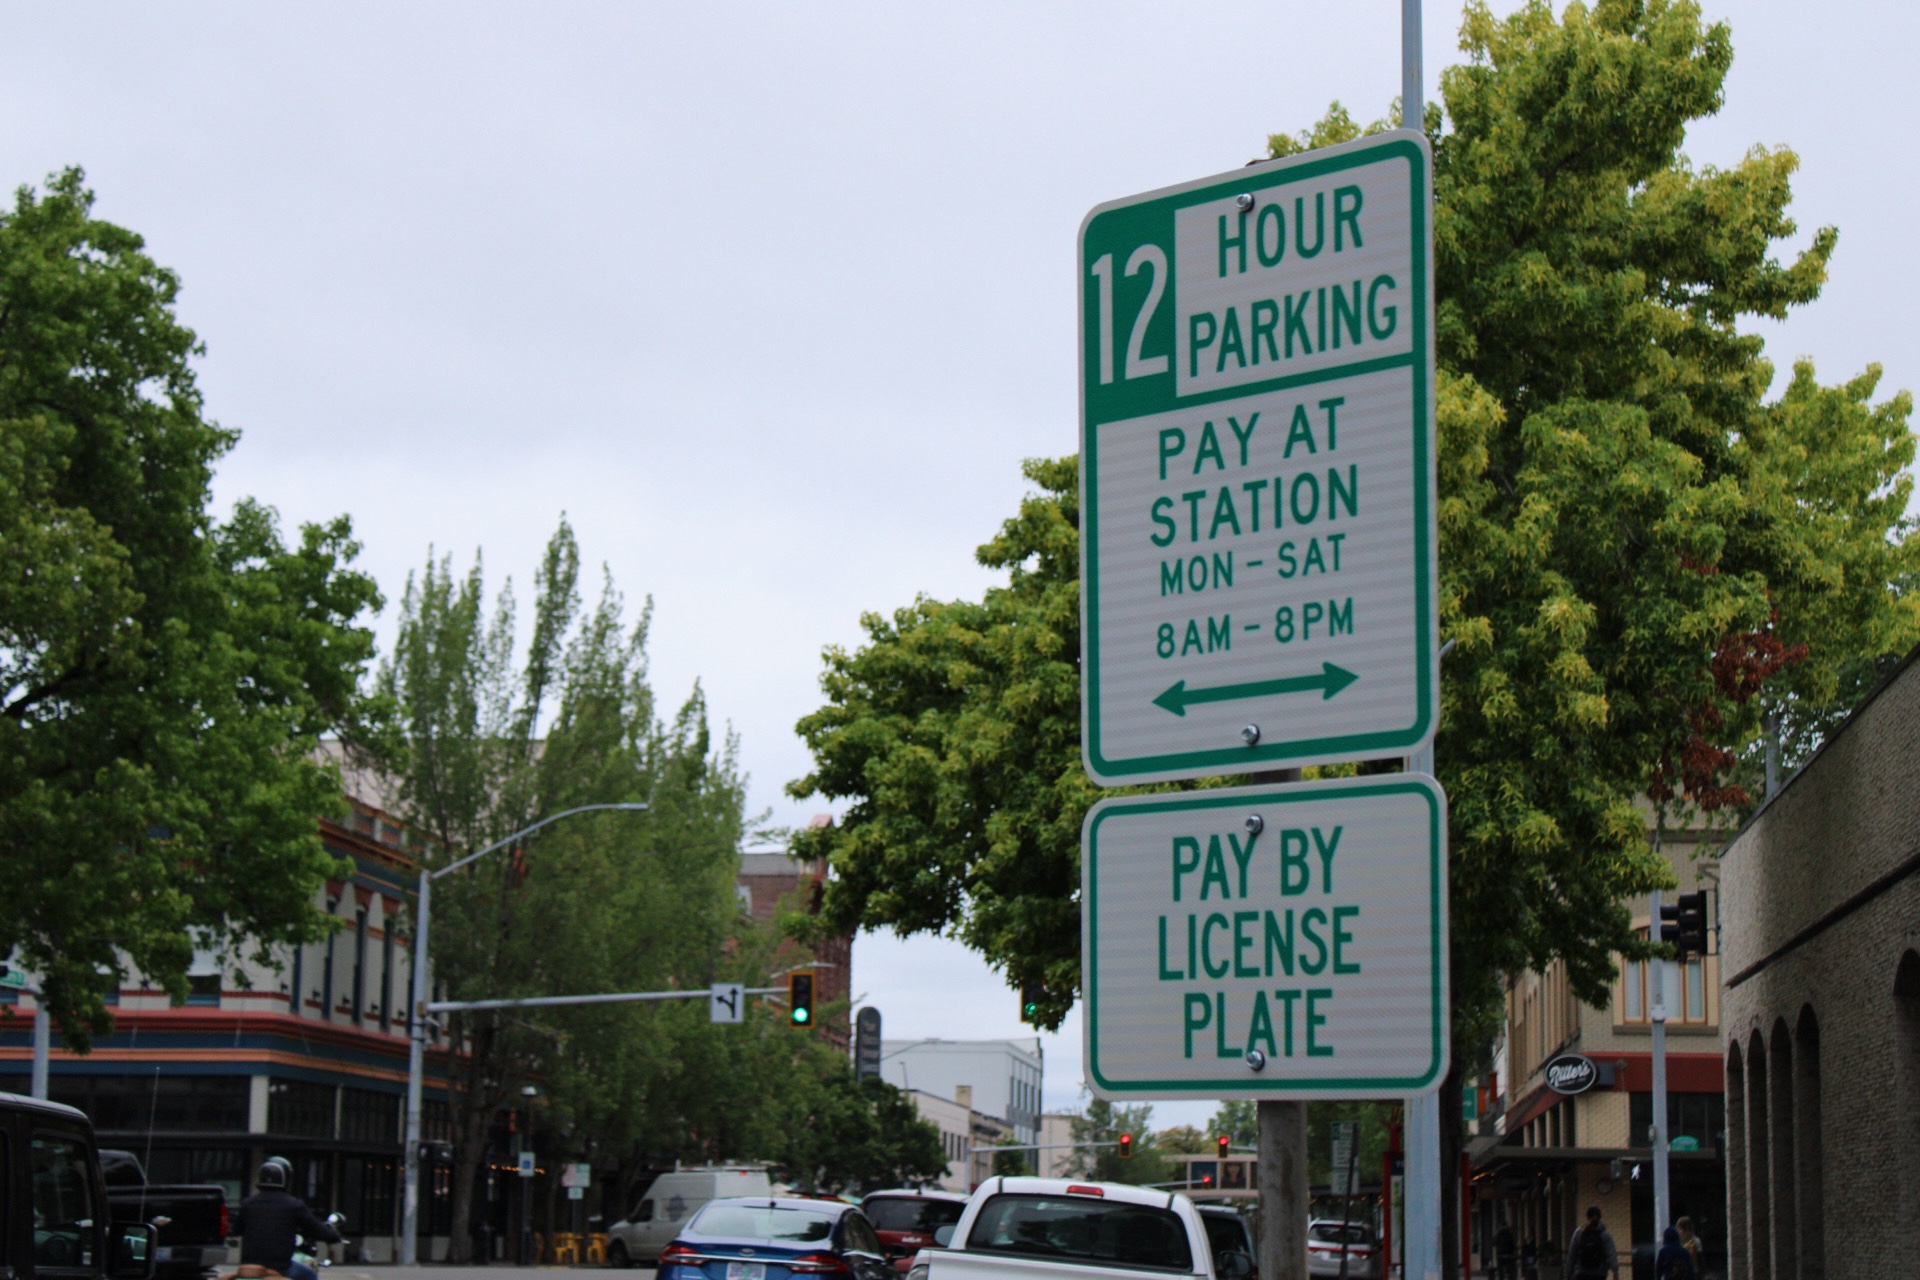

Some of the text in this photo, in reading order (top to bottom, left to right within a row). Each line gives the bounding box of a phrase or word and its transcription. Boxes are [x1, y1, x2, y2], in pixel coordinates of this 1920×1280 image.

[1218, 184, 1364, 279] HOUR
[1091, 243, 1169, 385] 12
[1189, 273, 1398, 379] PARKING
[1159, 396, 1346, 481] PAY AT
[1150, 463, 1359, 548] STATION
[1160, 550, 1234, 598] MON
[1278, 532, 1346, 579] SAT
[1156, 614, 1231, 660] 8AM
[1275, 596, 1354, 645] 8PM
[1172, 824, 1344, 903] PAY BY
[1158, 905, 1361, 981] LICENSE
[1184, 988, 1335, 1060] PLATE
